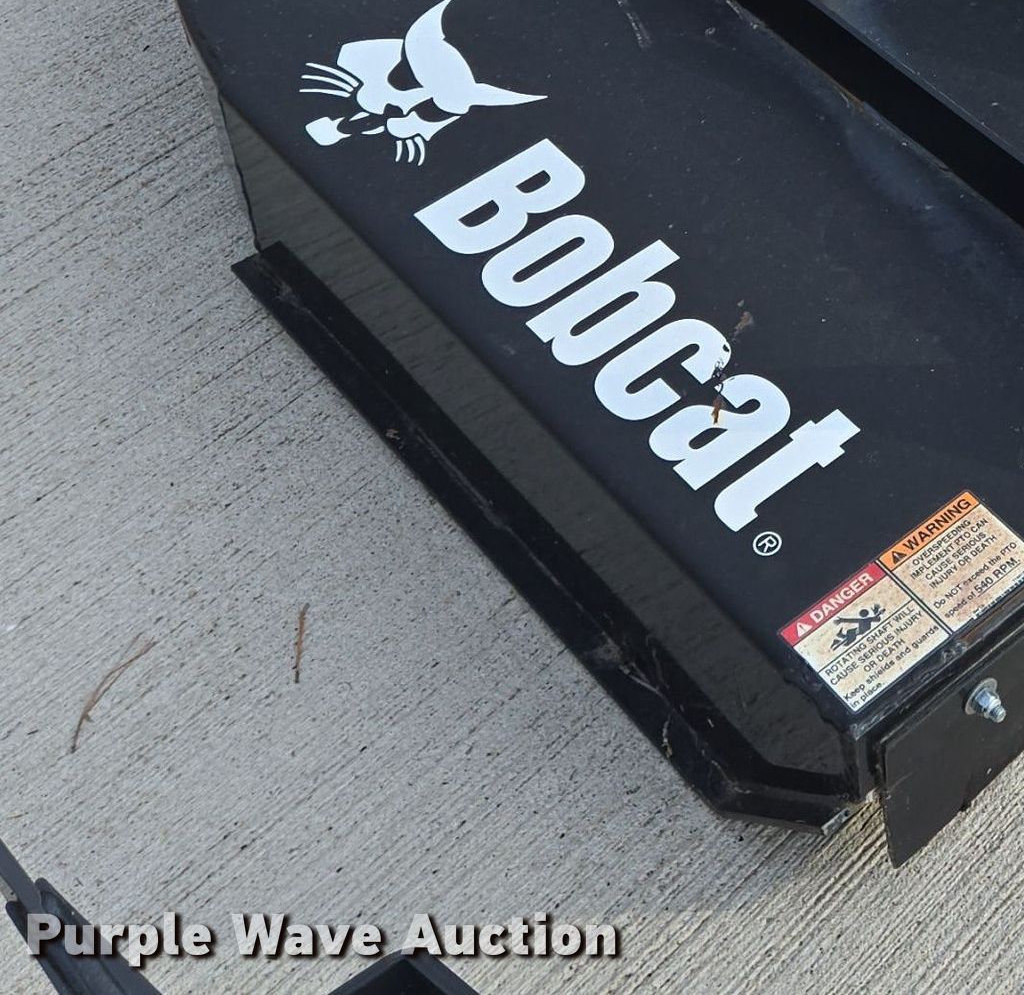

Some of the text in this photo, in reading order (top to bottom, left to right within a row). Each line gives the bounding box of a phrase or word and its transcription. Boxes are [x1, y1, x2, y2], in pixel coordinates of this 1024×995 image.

[413, 138, 861, 532] Bobcat
[903, 497, 971, 550] WARNING
[909, 517, 988, 579] IMPLEMENT PTO CAN
[911, 519, 971, 566] OVERSPEEDING
[924, 531, 987, 580] CAUSE SERIOUS
[928, 564, 959, 588] INJURY
[956, 554, 971, 567] OR
[969, 534, 997, 557] DEATH
[932, 541, 1018, 609] Do NOT exceed the PTO
[809, 571, 874, 623] DANGER
[942, 554, 1021, 619] speed of 540 RPM.
[824, 605, 915, 676] ROTATING SHAFT WILL
[828, 610, 924, 686] CAUSE SERIOUS INJURY
[843, 624, 940, 701] Keep shields and guards
[862, 637, 905, 672] OR DEATH
[849, 679, 885, 708] in place.
